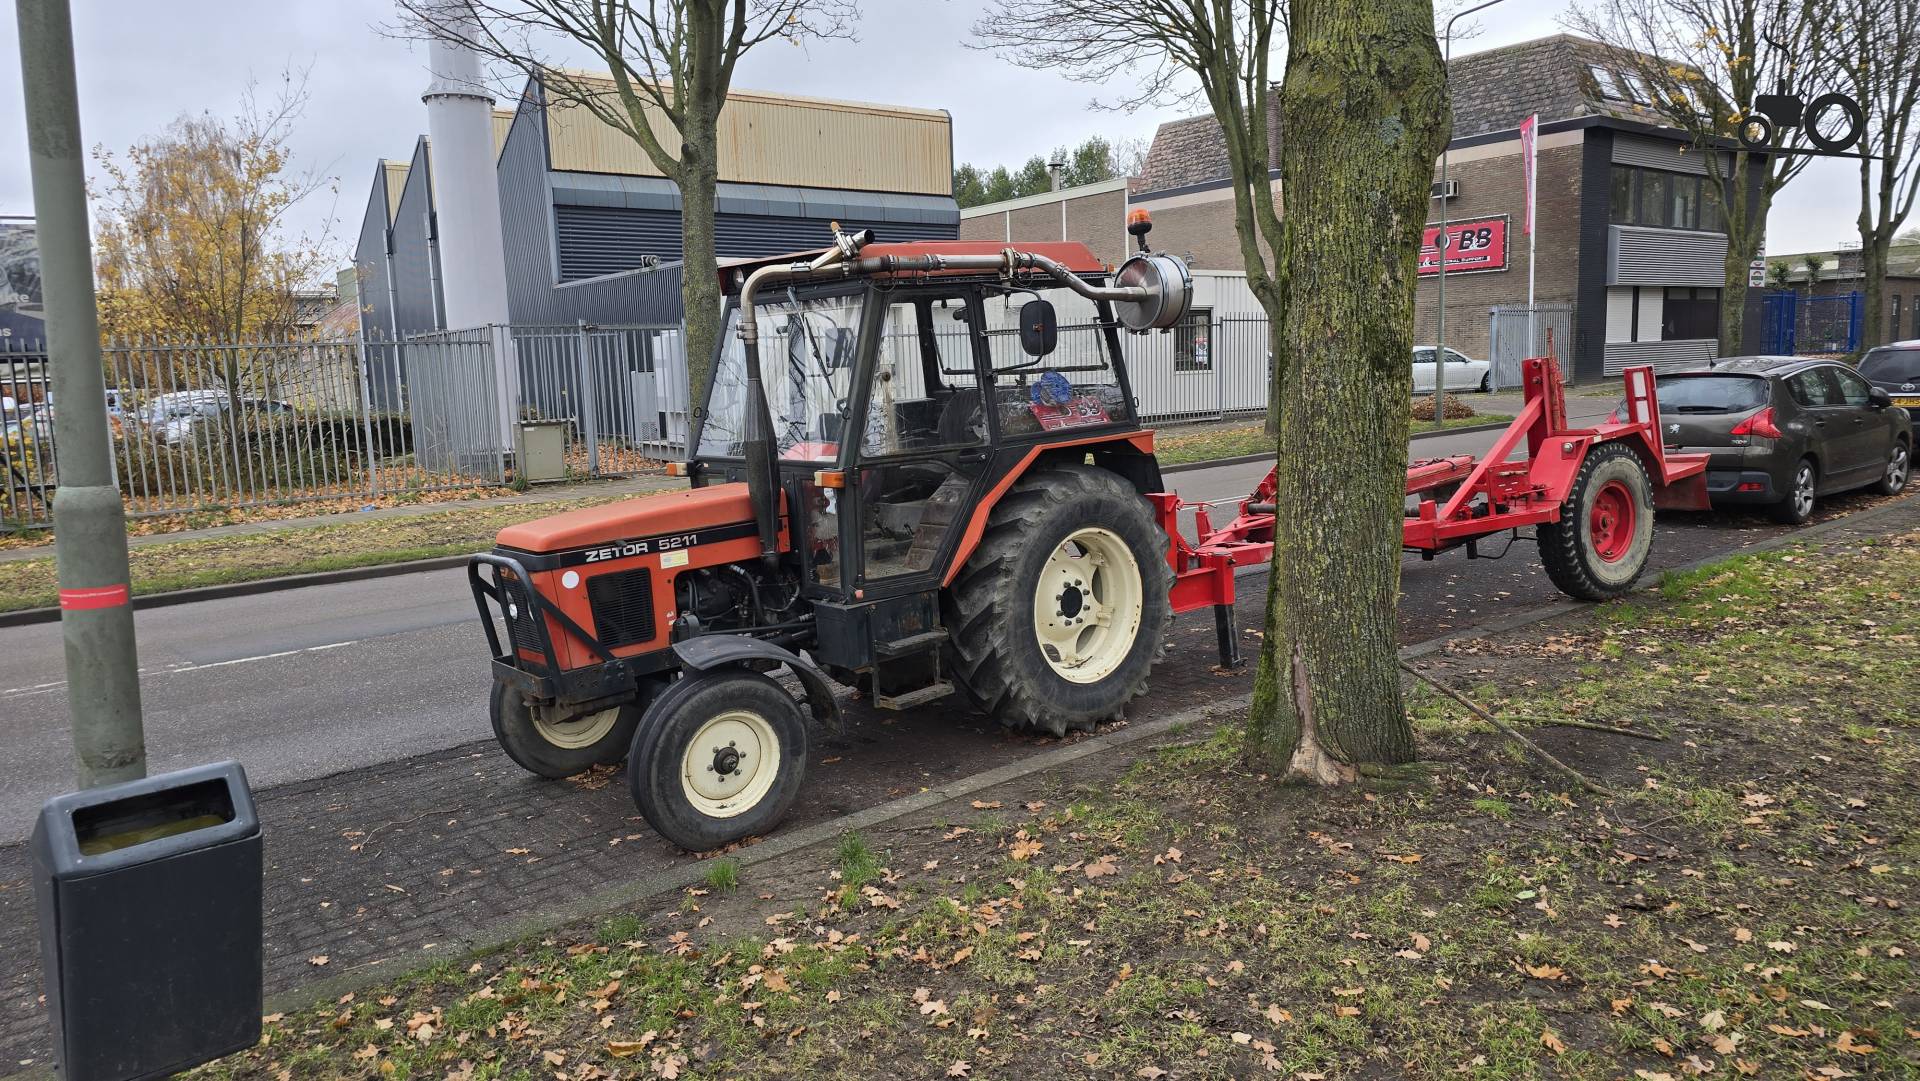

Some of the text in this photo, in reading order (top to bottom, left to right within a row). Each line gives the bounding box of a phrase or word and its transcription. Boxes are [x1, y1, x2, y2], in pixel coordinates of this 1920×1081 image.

[1459, 228, 1491, 251] B&B
[585, 542, 649, 562] ZETOR
[659, 534, 698, 550] 5211
